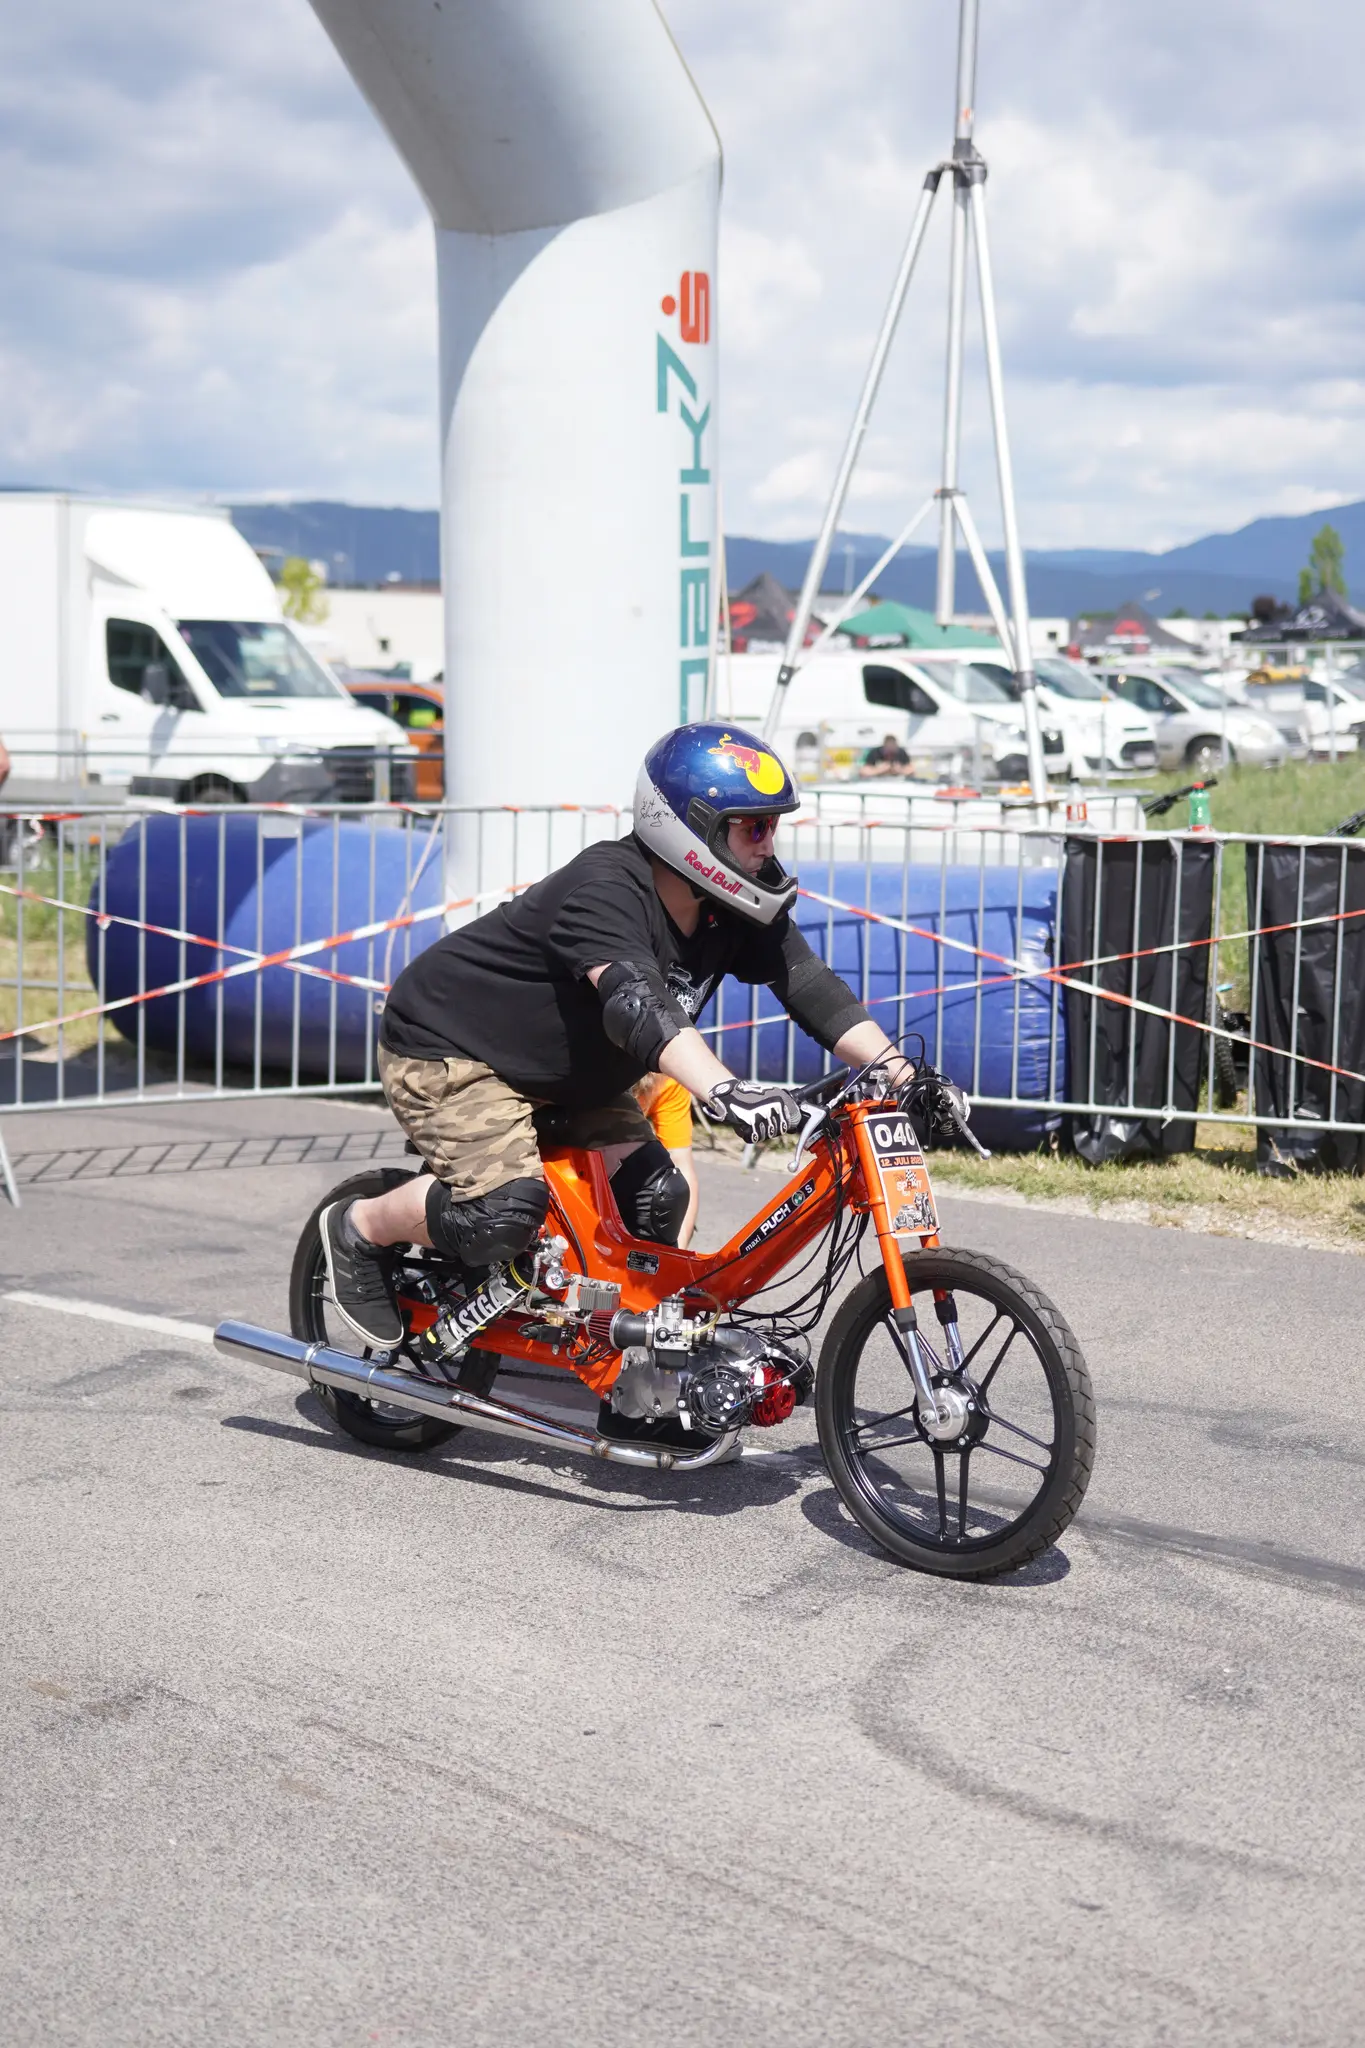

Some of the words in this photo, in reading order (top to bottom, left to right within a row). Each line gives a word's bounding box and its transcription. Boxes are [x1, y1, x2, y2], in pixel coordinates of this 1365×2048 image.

[684, 849, 714, 879] Red
[711, 870, 744, 896] Bull
[874, 1122, 916, 1148] 040
[894, 1156, 910, 1166] JULI
[745, 1235, 762, 1252] maxi
[760, 1203, 791, 1236] PUCH
[805, 1184, 813, 1194] S
